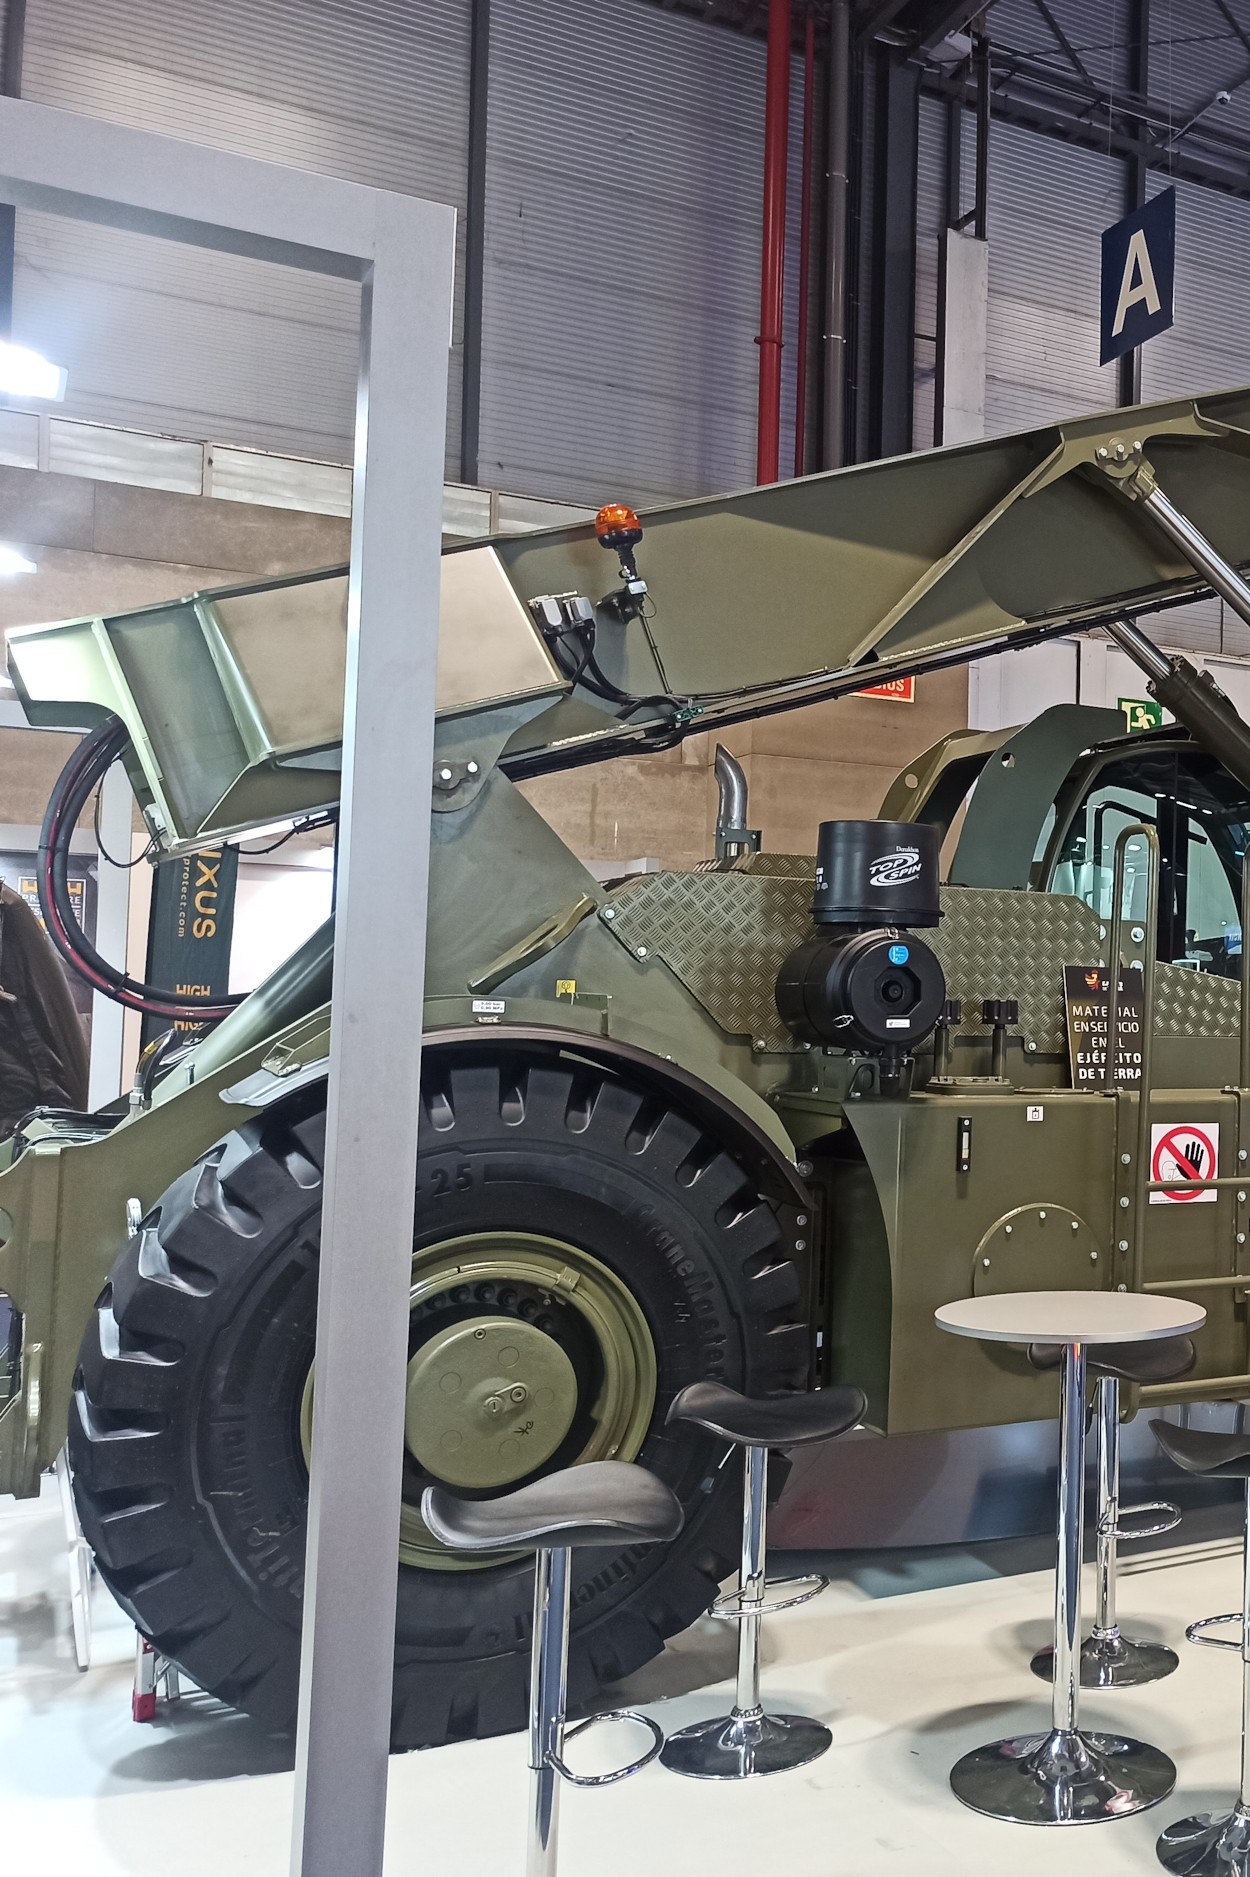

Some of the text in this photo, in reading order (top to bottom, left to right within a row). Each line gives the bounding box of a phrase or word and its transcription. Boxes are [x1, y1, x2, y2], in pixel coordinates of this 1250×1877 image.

[1111, 228, 1162, 338] A
[869, 858, 904, 875] TOP
[888, 863, 922, 880] SPIN
[1072, 1005, 1139, 1018] MATEIAL
[1091, 1021, 1140, 1033] SEICIO
[1091, 1037, 1107, 1048] EN
[1076, 1050, 1142, 1064] EJÉRITO
[1078, 1068, 1142, 1080] DE TERRA
